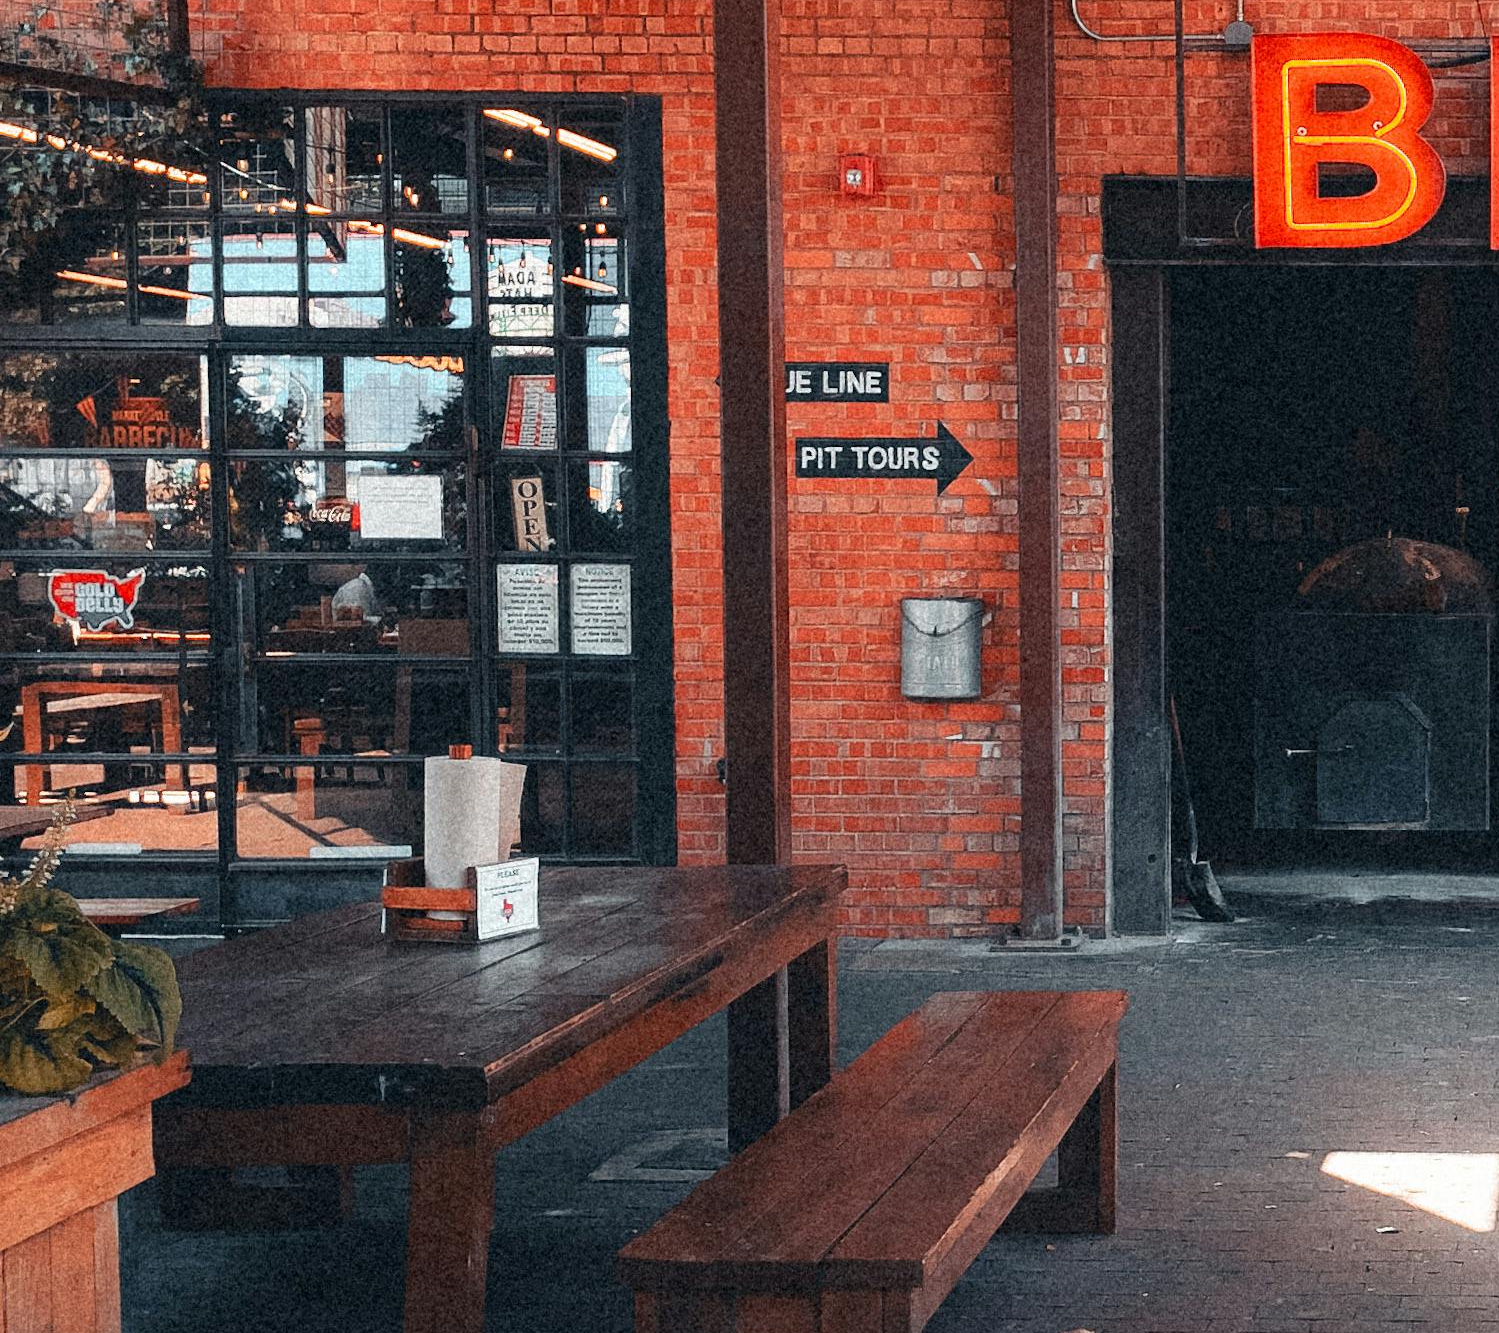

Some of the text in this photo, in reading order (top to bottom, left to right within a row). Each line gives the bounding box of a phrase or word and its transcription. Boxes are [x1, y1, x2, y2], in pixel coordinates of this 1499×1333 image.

[822, 370, 882, 394] LINE
[801, 445, 941, 470] PIT TOURS
[517, 480, 541, 552] OPEN
